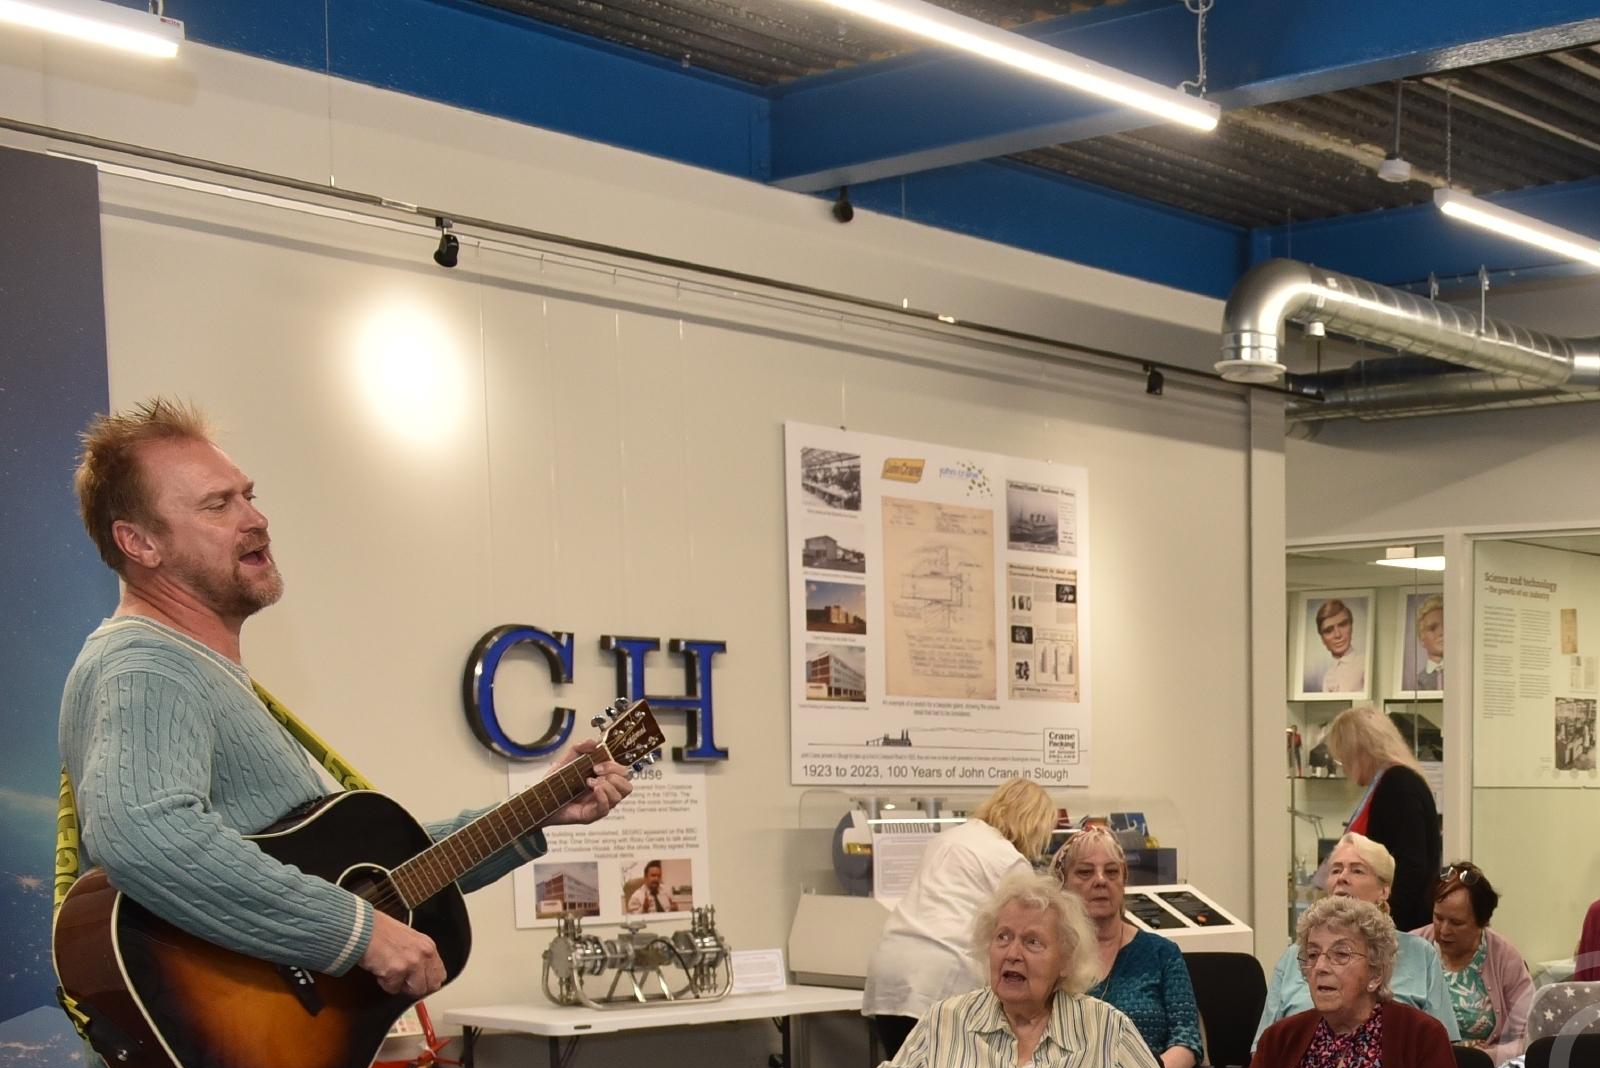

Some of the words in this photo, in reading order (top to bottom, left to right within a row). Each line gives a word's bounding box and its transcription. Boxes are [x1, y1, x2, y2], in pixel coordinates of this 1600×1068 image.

[1485, 572, 1508, 584] Science
[1510, 576, 1522, 586] and
[1524, 576, 1557, 592] technology
[1048, 731, 1076, 740] Crane
[630, 770, 662, 780] ouse
[803, 764, 832, 777] 1923
[835, 765, 847, 777] to
[850, 765, 884, 779] 2023,
[888, 766, 908, 778] 100
[910, 766, 943, 778] Years
[946, 766, 956, 778] of
[958, 767, 985, 779] John
[988, 767, 1020, 779] Crane
[1022, 768, 1032, 779] in
[1034, 768, 1068, 782] Slough
